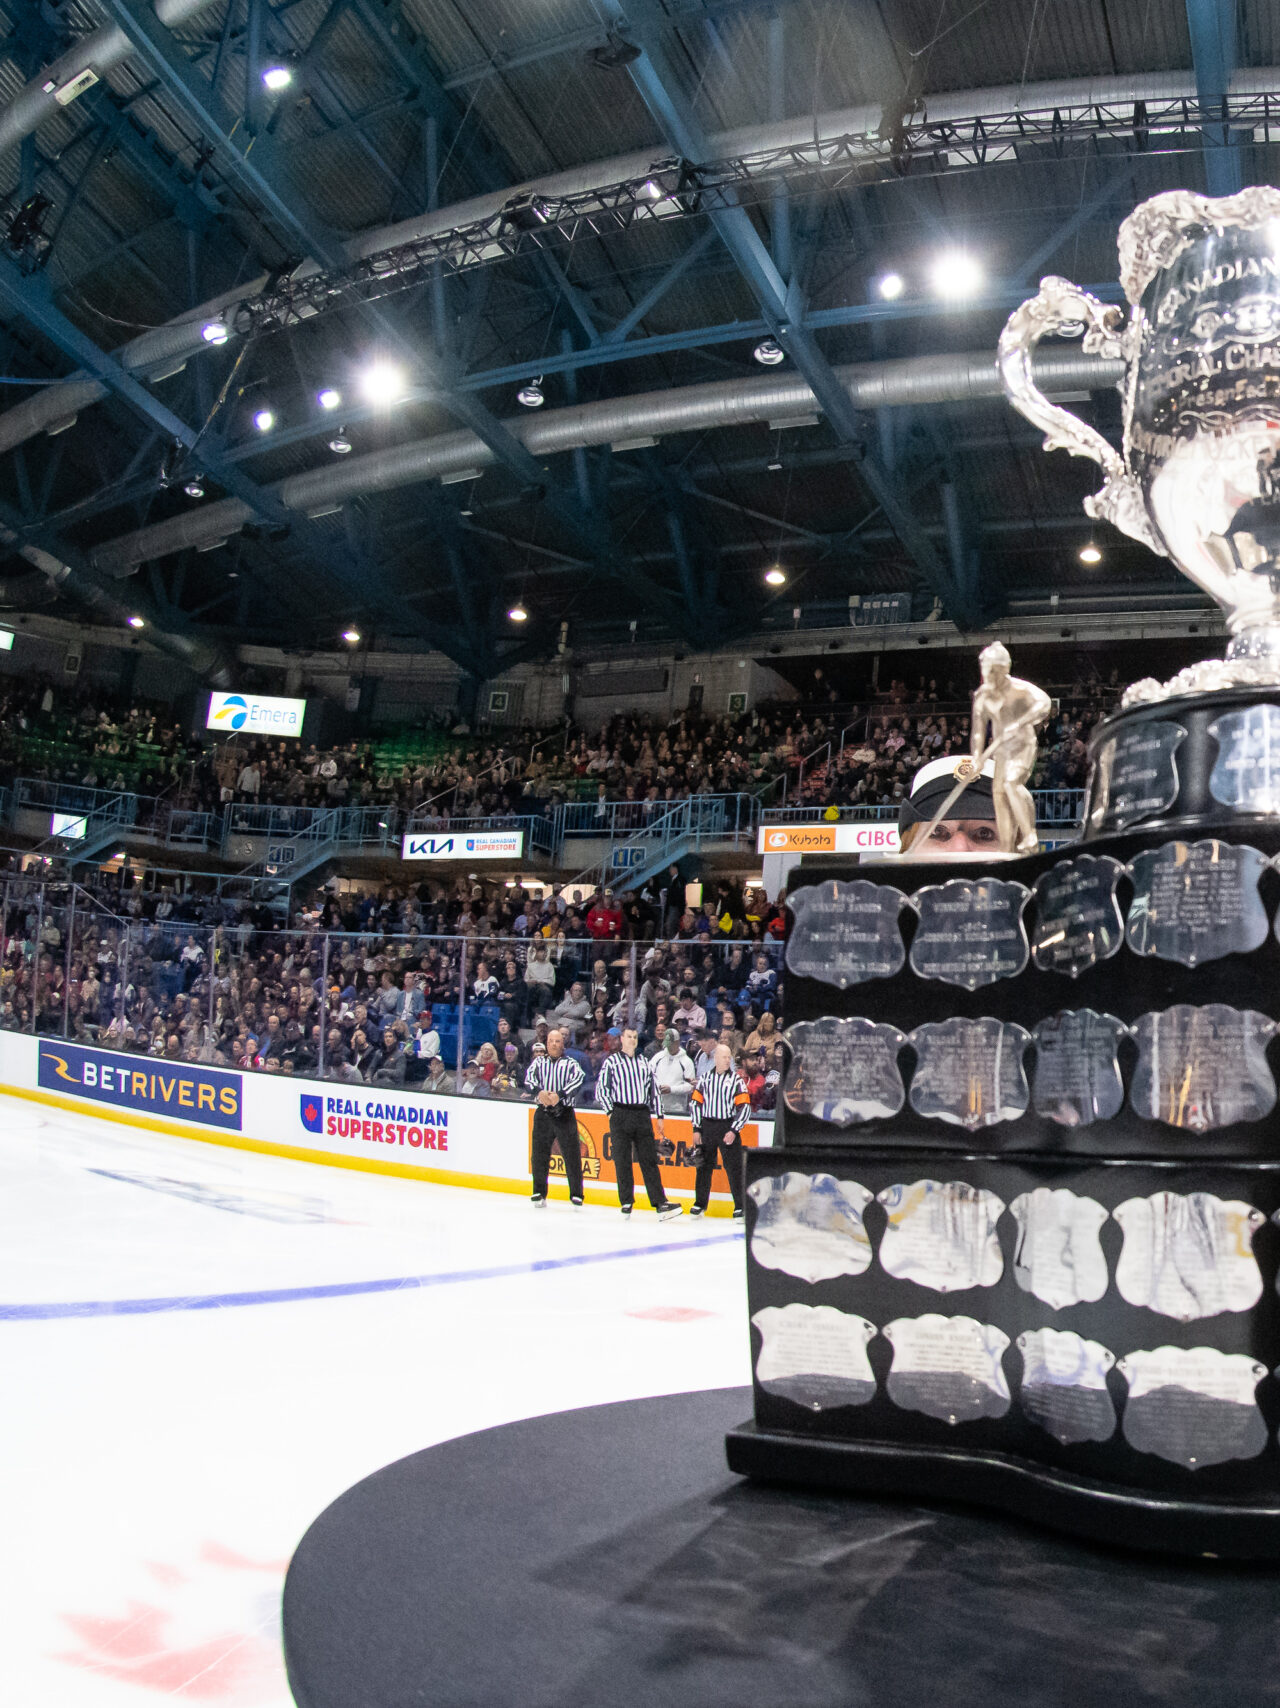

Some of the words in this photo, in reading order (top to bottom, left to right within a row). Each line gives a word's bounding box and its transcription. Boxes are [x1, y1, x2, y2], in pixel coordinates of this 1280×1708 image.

[250, 704, 297, 724] Emera
[410, 839, 454, 854] KIA
[476, 843, 516, 851] SUPERSTORE
[789, 834, 831, 846] Kubota
[856, 830, 897, 846] CIBC
[83, 1061, 238, 1115] BETRIVERS
[327, 1097, 362, 1116] REAL
[365, 1102, 449, 1127] CANADIAN
[327, 1115, 449, 1151] SUPERSTORE
